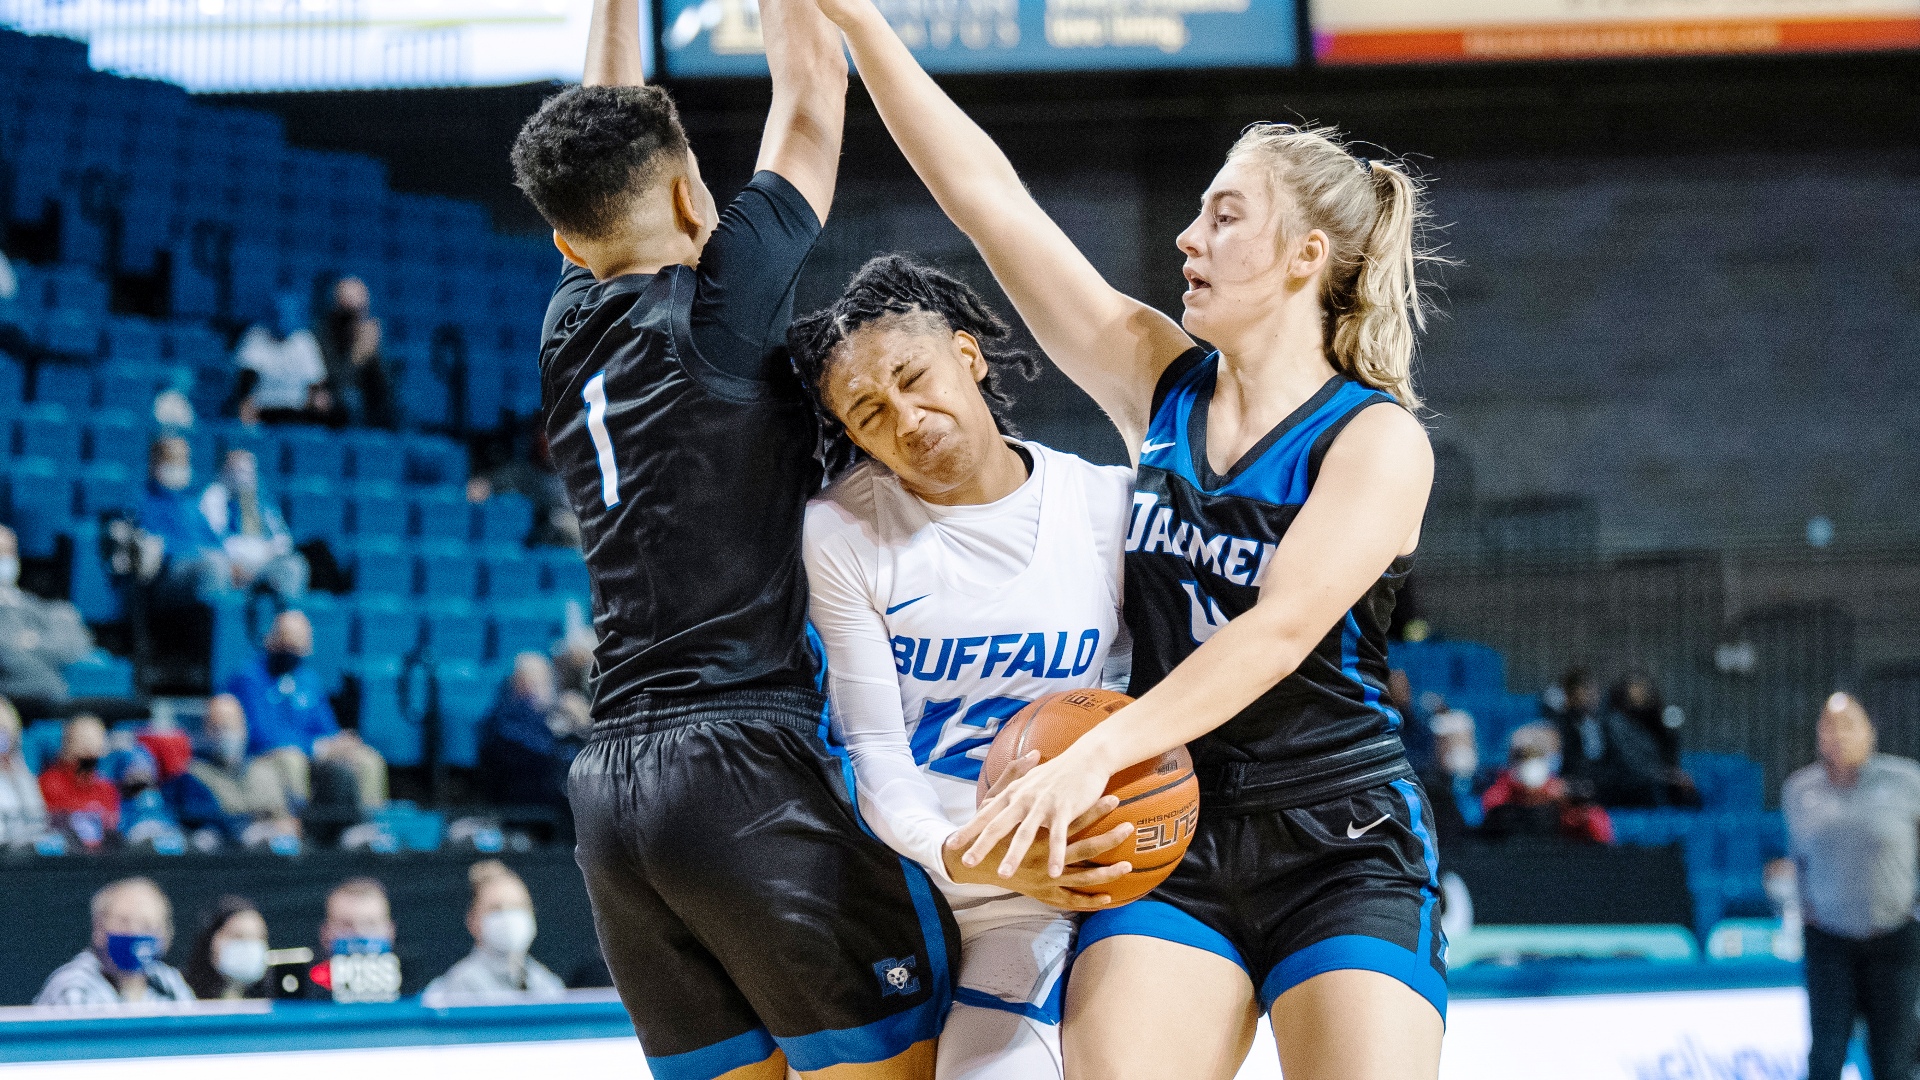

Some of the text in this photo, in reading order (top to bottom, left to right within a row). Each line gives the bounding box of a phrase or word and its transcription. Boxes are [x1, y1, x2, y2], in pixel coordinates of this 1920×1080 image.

[580, 369, 622, 511] 1
[890, 628, 1100, 682] BUFFALO
[908, 693, 1033, 785] 12
[1134, 805, 1198, 854] ELITE
